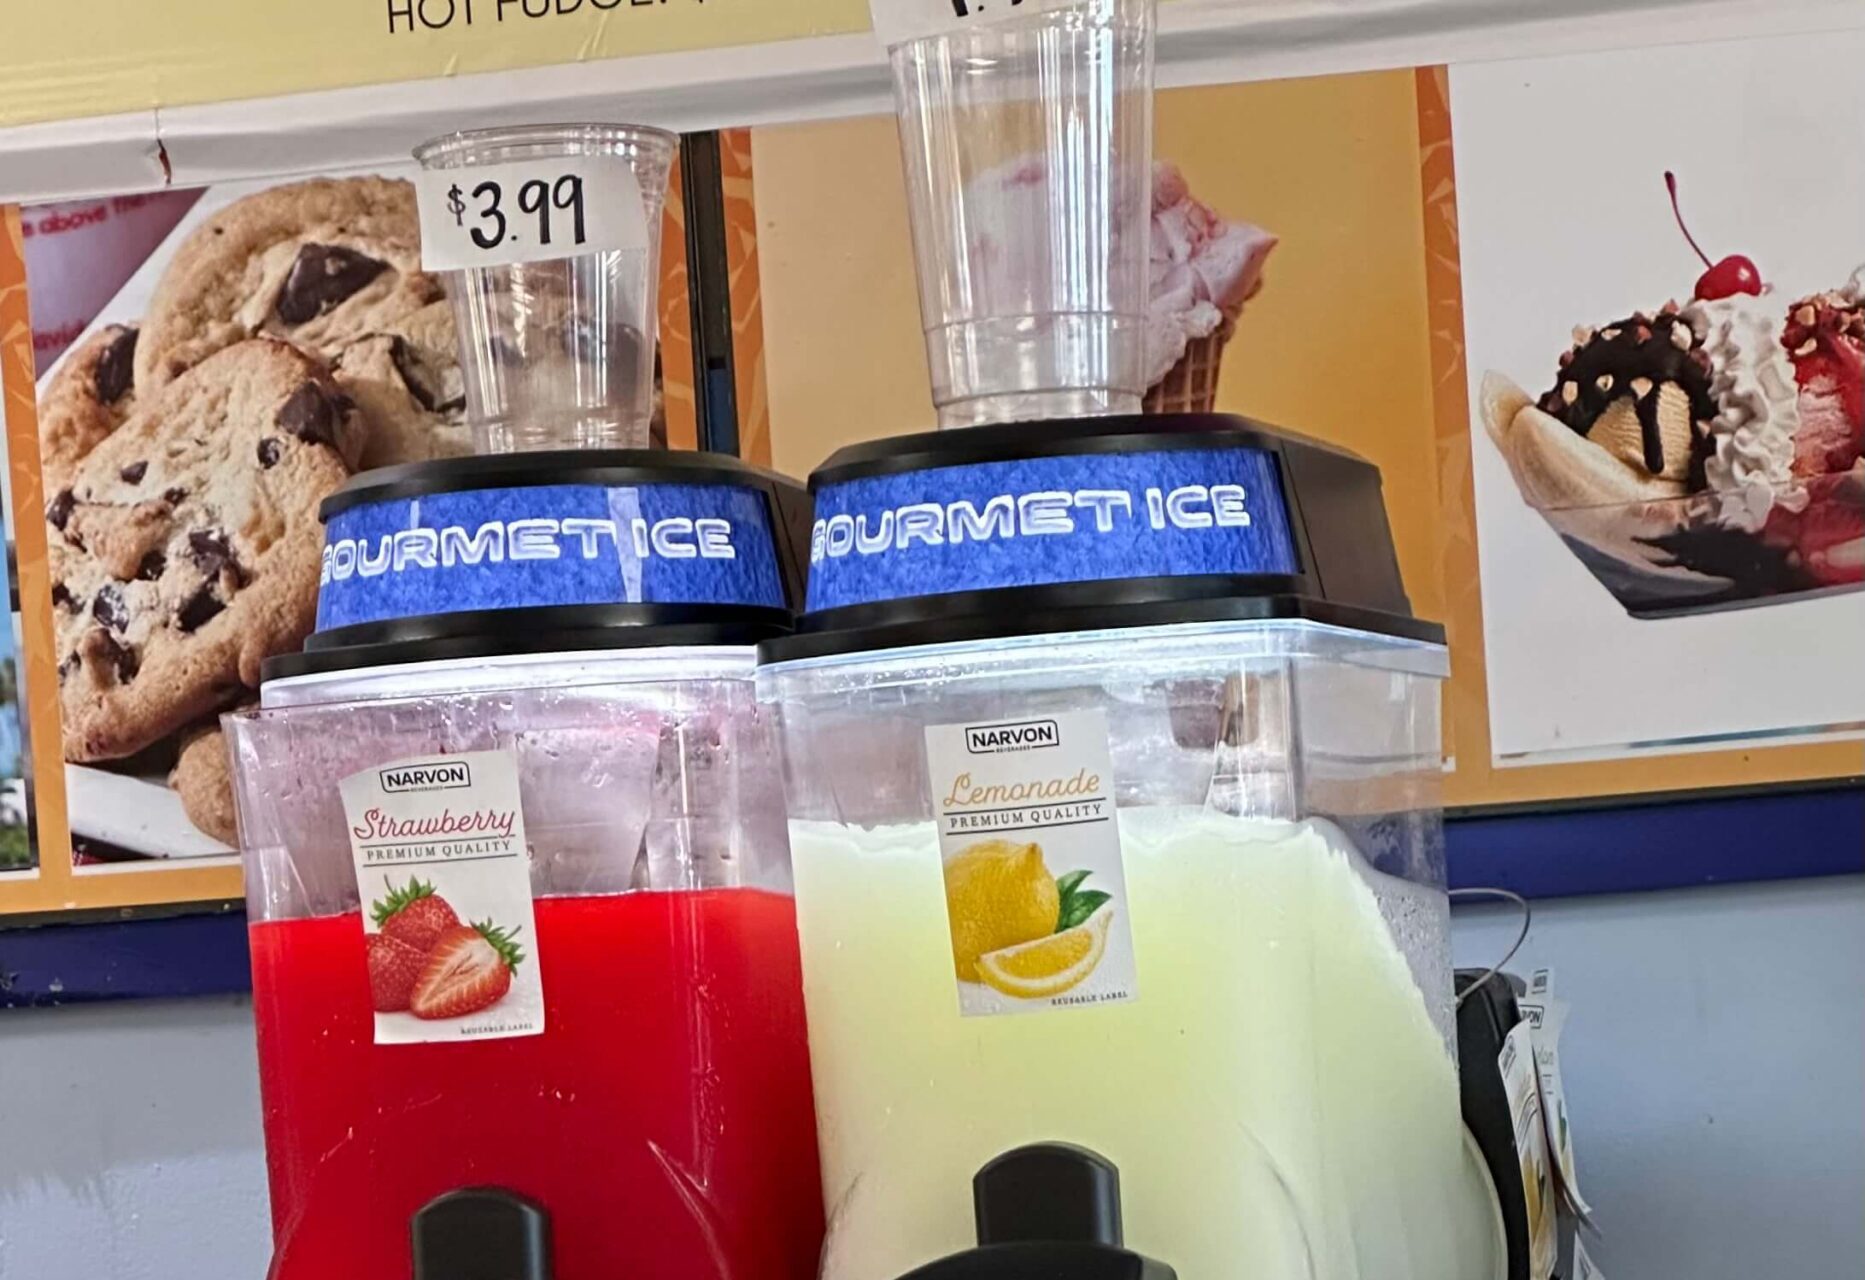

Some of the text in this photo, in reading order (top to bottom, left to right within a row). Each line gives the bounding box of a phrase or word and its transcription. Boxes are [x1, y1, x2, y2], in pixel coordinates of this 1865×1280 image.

[446, 174, 586, 249] $3.99
[810, 484, 1251, 563] GOURMET ICE
[320, 517, 736, 587] GOURMET ICE
[972, 726, 1053, 748] NARVON
[387, 767, 464, 787] NARVON
[943, 768, 1100, 808] Lemonade
[353, 808, 515, 840] Strawberry
[950, 804, 1102, 829] PREMIUM QUALITY
[367, 840, 511, 861] PREMIUM QUALITY
[1051, 991, 1129, 1006] REUSABLE LABEL
[507, 1023, 533, 1032] LABEL
